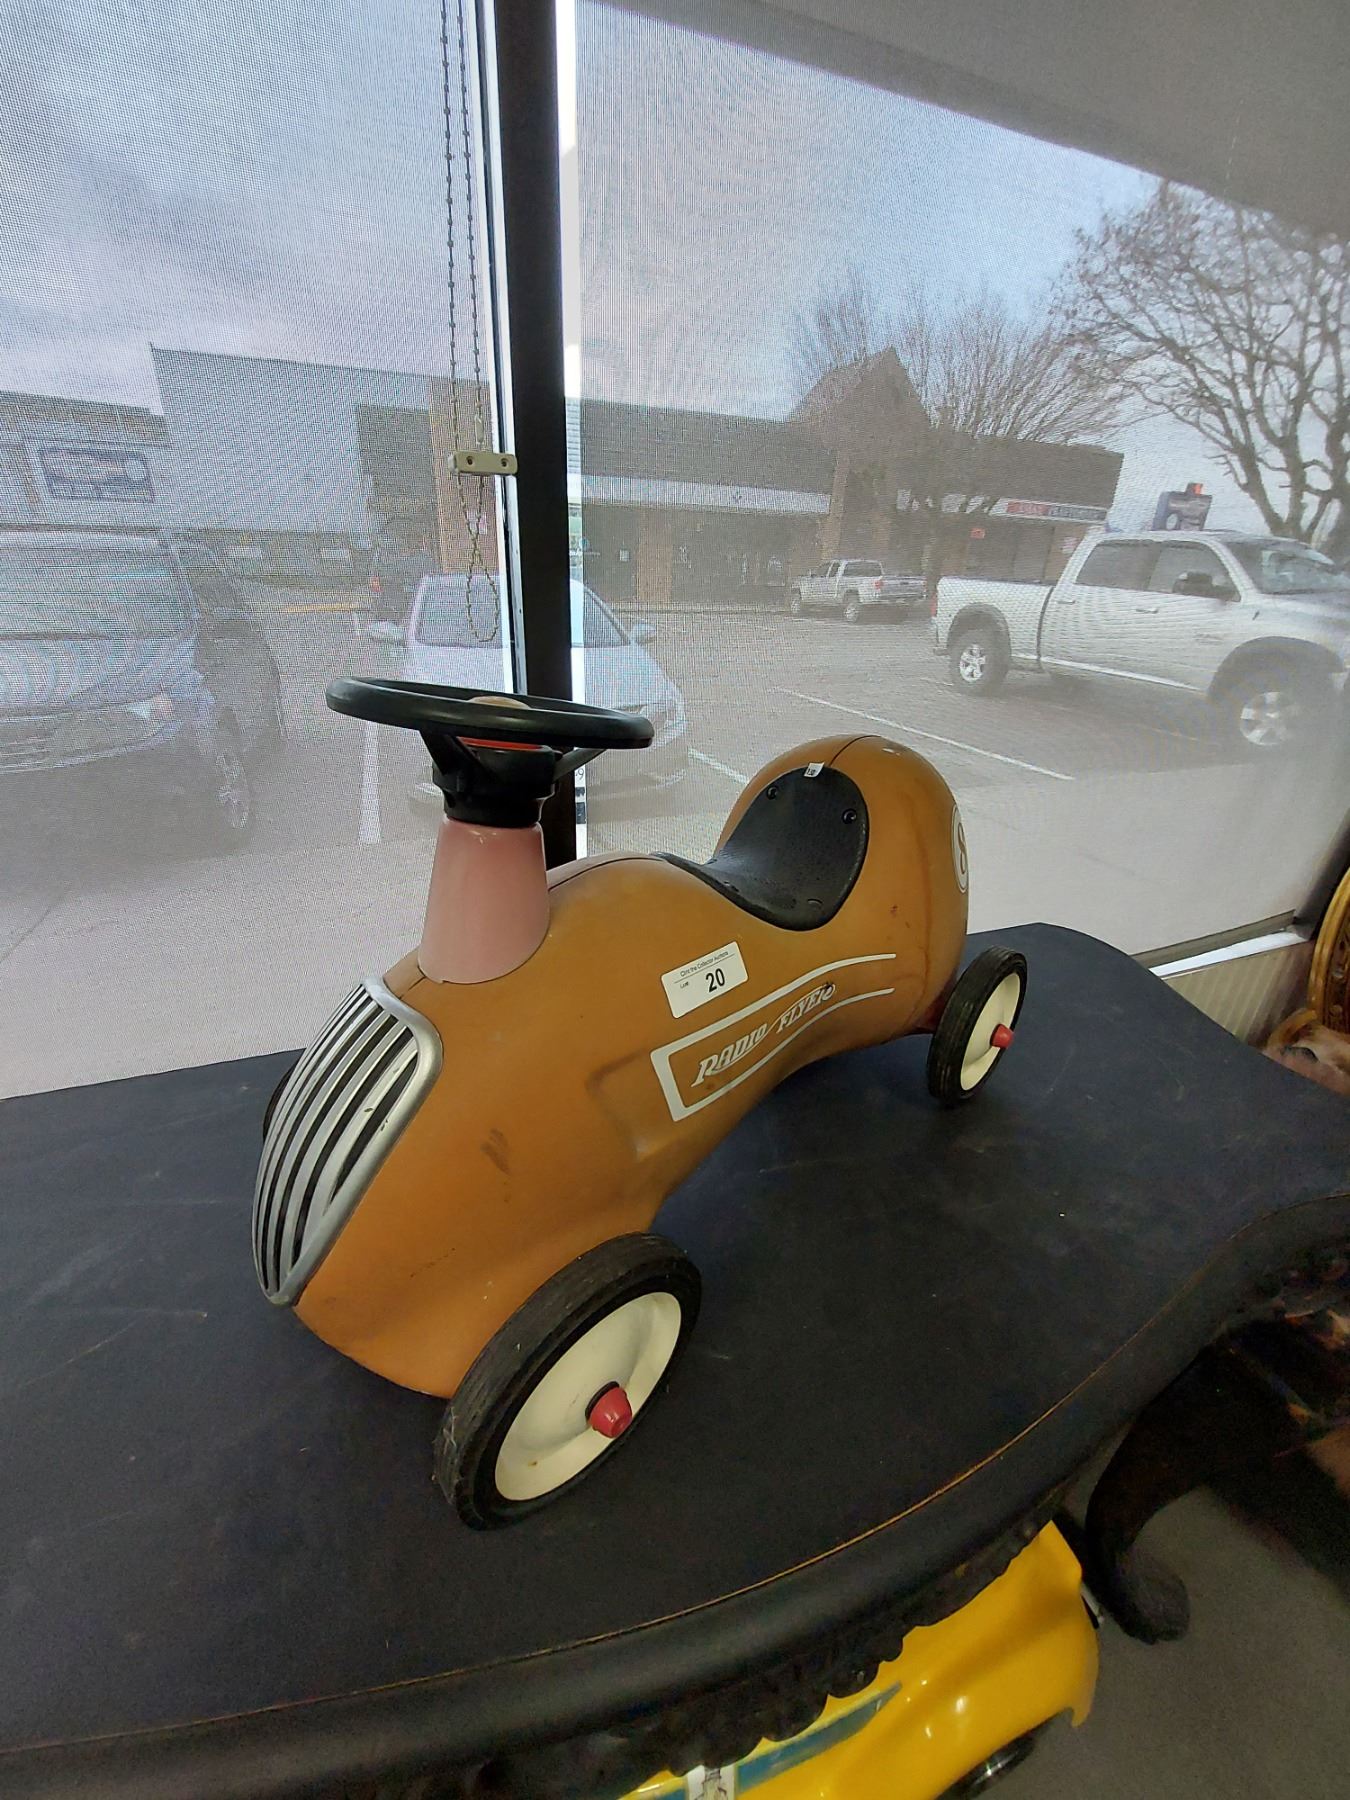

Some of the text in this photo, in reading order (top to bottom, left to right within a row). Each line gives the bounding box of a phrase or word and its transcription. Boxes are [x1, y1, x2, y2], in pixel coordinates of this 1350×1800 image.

[957, 822, 968, 875] 8
[705, 968, 725, 993] 20
[690, 983, 836, 1087] RADIO FLYER
